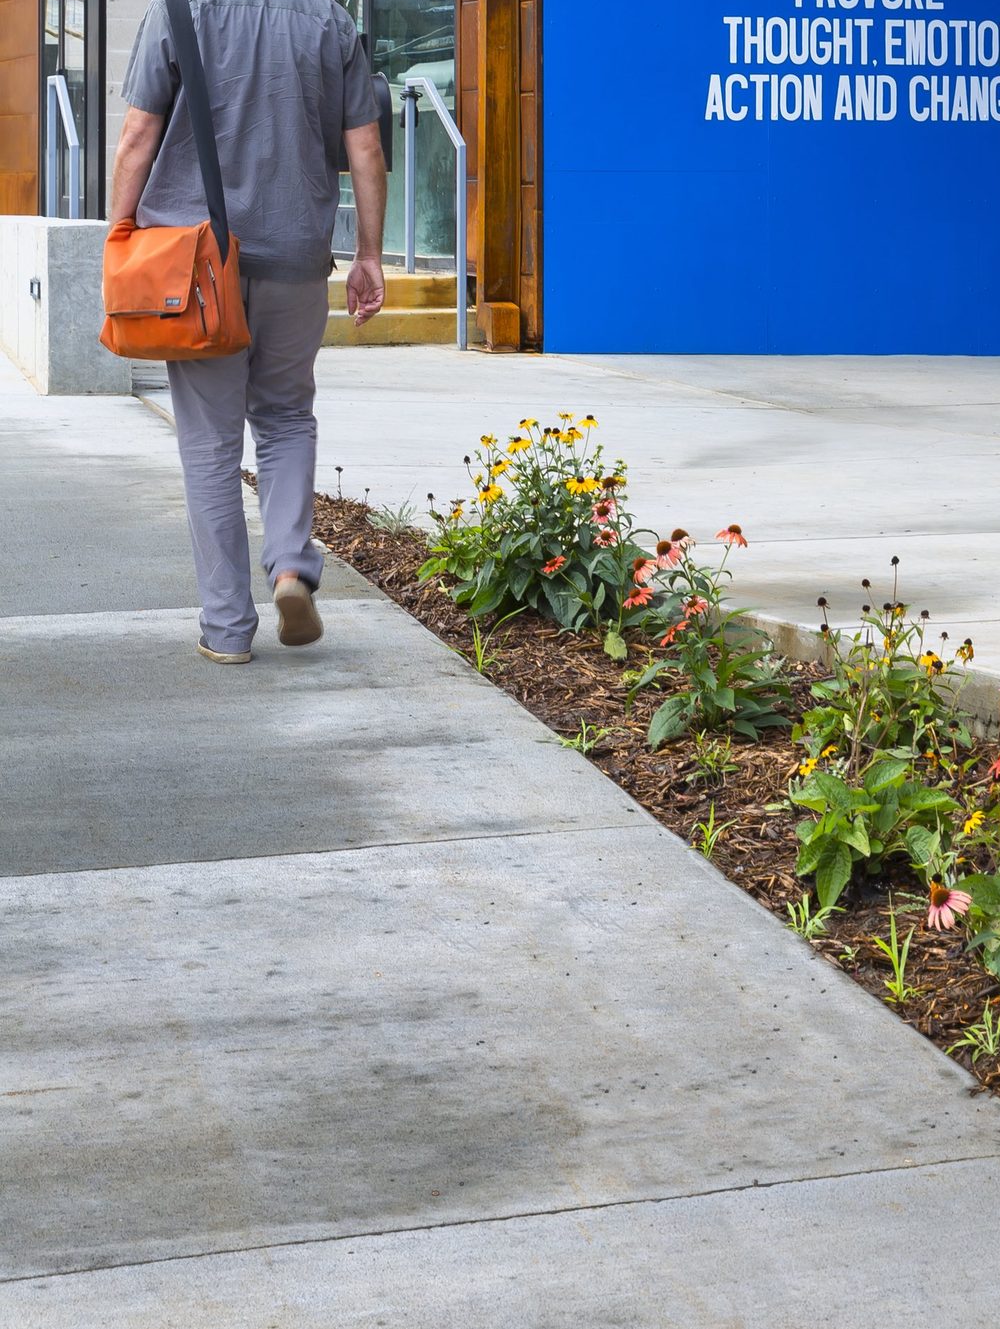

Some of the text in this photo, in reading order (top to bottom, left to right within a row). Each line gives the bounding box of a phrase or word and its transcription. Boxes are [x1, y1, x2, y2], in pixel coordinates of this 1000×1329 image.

[723, 17, 878, 67] THOUGHT,
[705, 74, 823, 121] ACTION
[834, 75, 898, 121] AND
